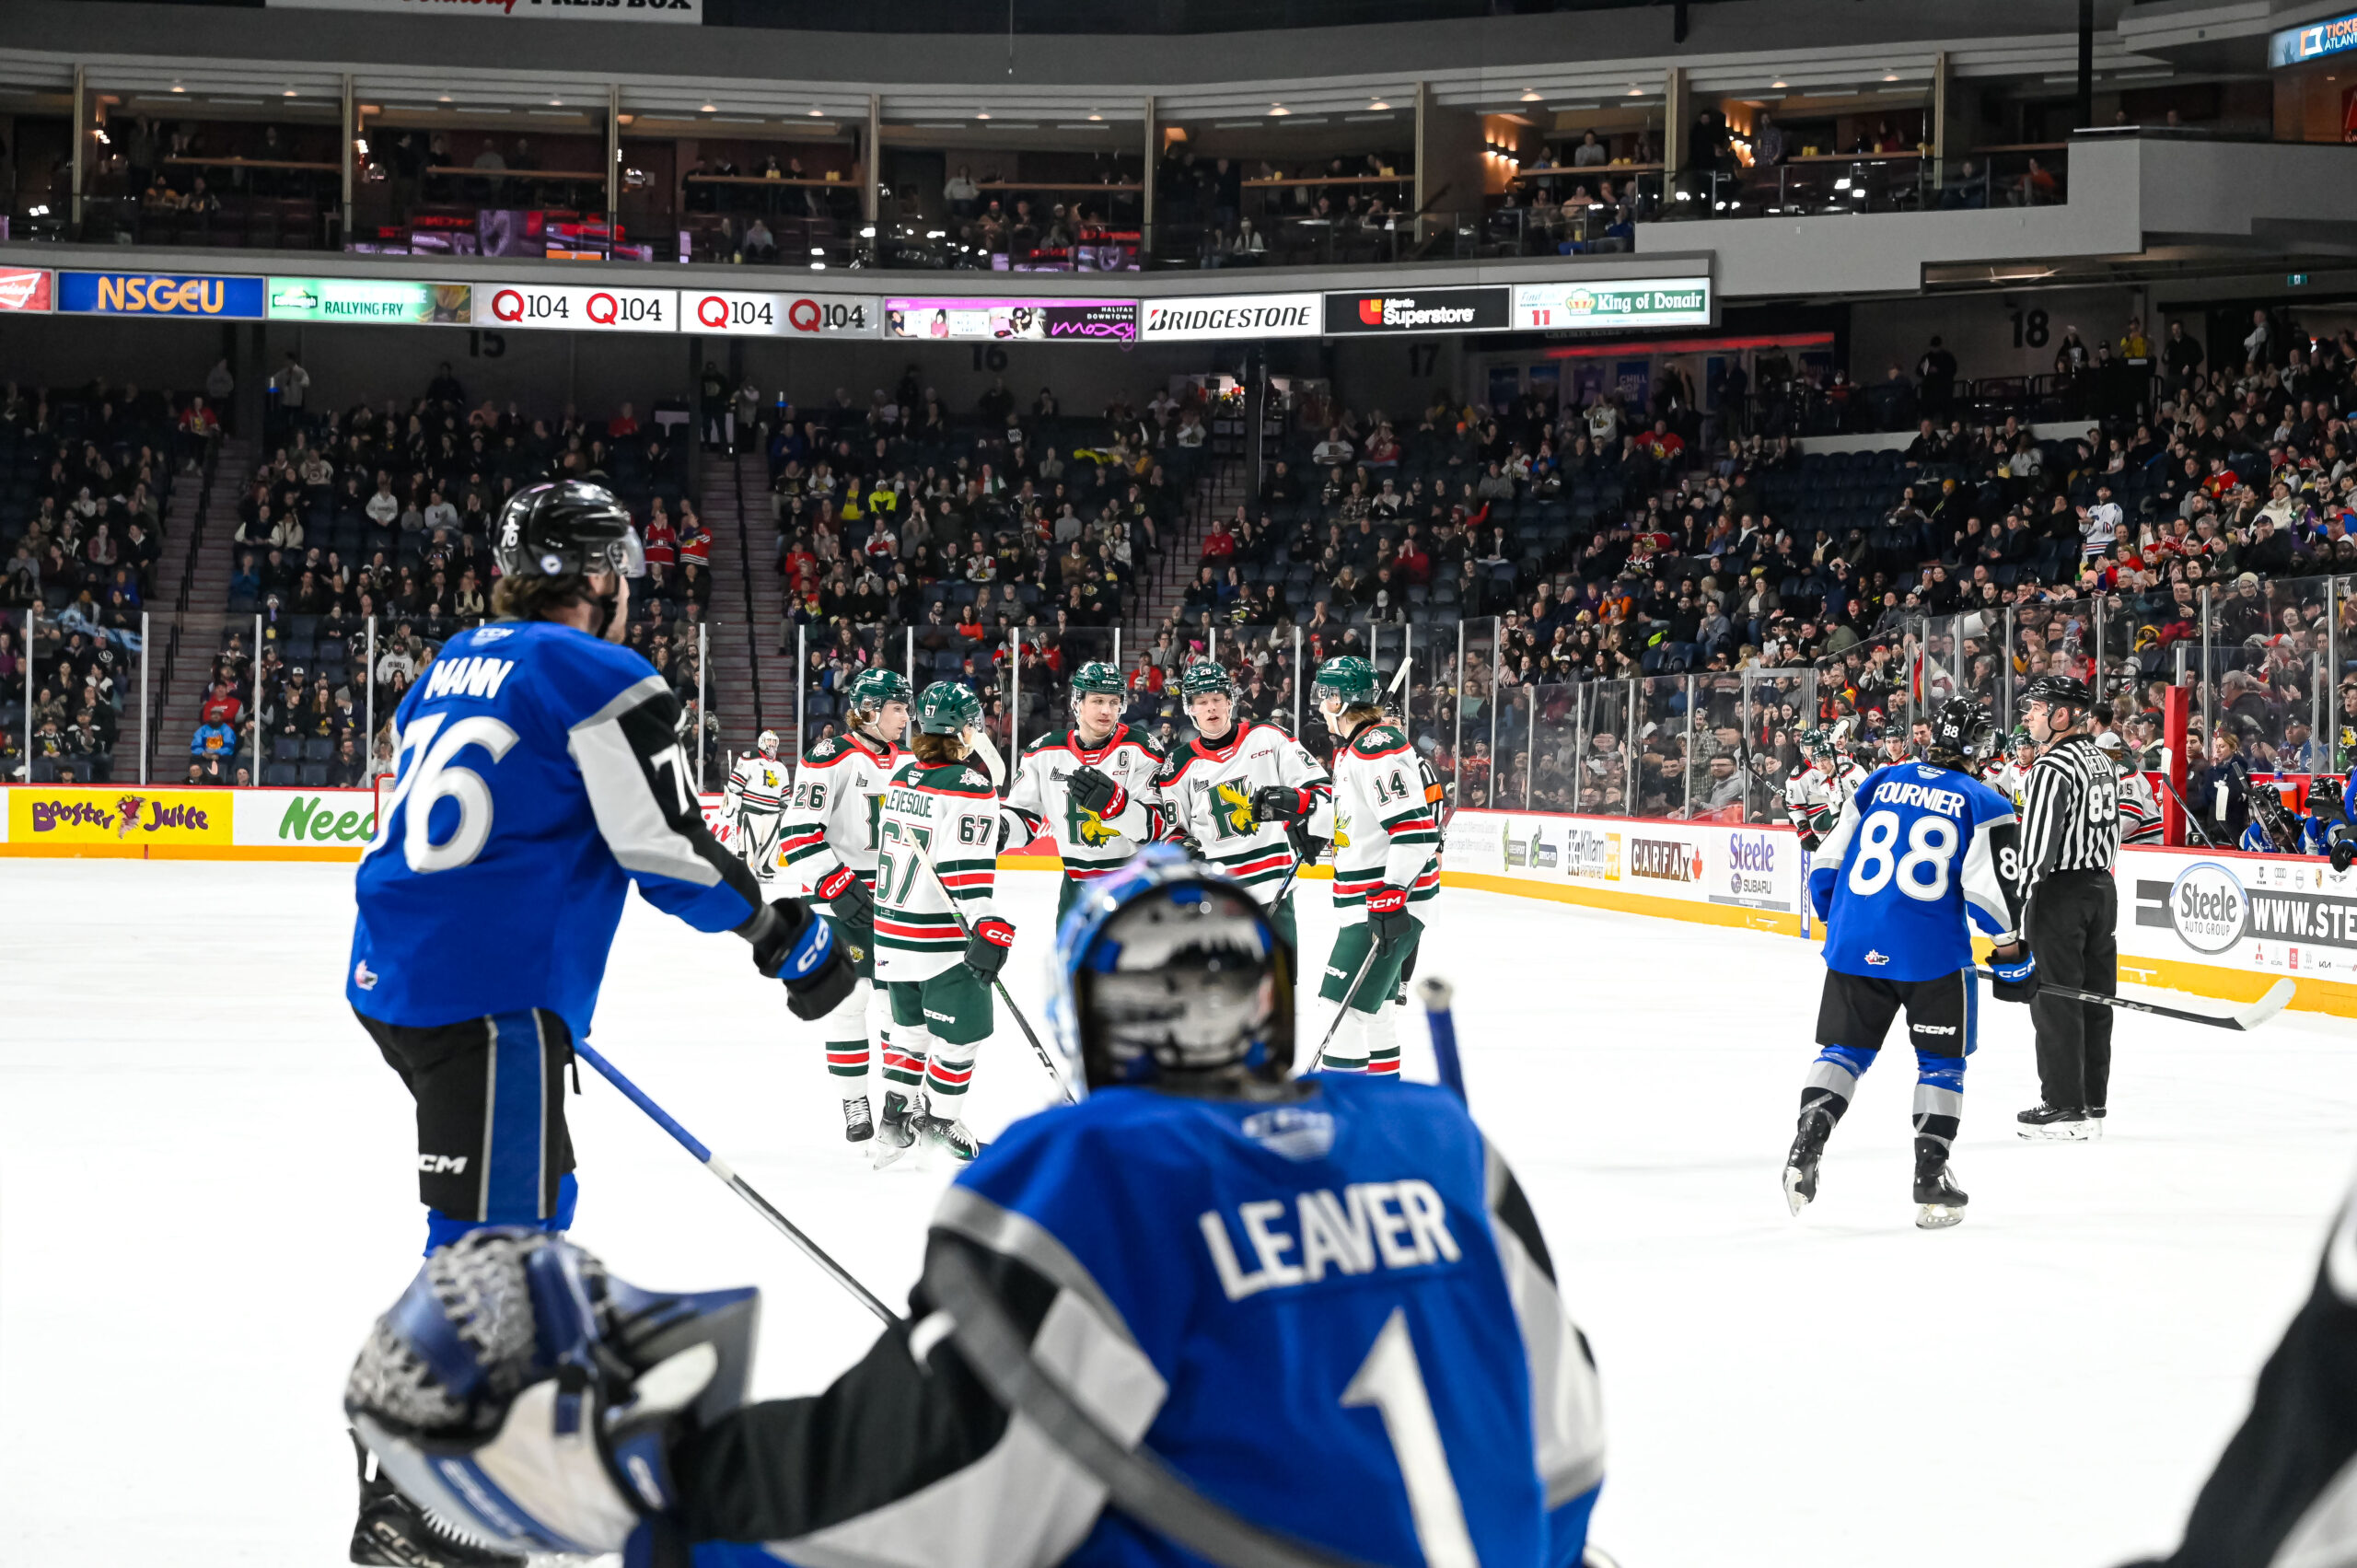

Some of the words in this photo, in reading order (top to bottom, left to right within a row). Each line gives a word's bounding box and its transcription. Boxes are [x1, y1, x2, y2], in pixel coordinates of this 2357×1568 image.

[98, 276, 224, 313] NSGEU
[325, 301, 379, 315] RALLYING
[382, 303, 403, 316] FRY
[1596, 294, 1631, 313] King
[1636, 293, 1649, 309] of
[1655, 292, 1702, 308] Donair
[1147, 307, 1312, 331] BRIDGESTONE
[1383, 307, 1473, 328] Superstore
[1532, 309, 1550, 325] 11
[2009, 309, 2049, 348] 18
[467, 330, 505, 358] 15
[970, 343, 1007, 372] 16
[1409, 343, 1440, 377] 17
[1619, 374, 1647, 384] CHILL
[424, 656, 515, 700] MANN
[924, 704, 936, 717] 67
[1942, 722, 1959, 738] 88
[1117, 749, 1130, 768] C
[1250, 748, 1273, 760] CCM
[2084, 755, 2108, 774] REID
[1916, 764, 1946, 775] CCM
[365, 713, 521, 873] 76
[793, 781, 828, 811] 26
[1374, 769, 1410, 807] 14
[1872, 783, 1966, 819] FOURNIER
[2088, 782, 2116, 823] 83
[32, 800, 115, 832] Booster
[144, 801, 209, 831] Juice
[885, 789, 934, 819] LEVESQUE
[958, 814, 994, 845] 67
[876, 818, 933, 908] 67
[1632, 839, 1691, 882] CARFAX
[1730, 832, 1774, 872] Steele
[1848, 810, 1960, 901] 88
[825, 865, 856, 897] CCM
[1743, 879, 1772, 894] SUBARU
[1366, 895, 1401, 910] CCM
[2181, 882, 2237, 922] Steele
[986, 928, 1014, 944] CC
[2185, 922, 2203, 934] AUTO
[2207, 923, 2230, 936] GROUP
[796, 918, 830, 973] CC
[923, 1007, 956, 1024] CCM
[2078, 993, 2154, 1014] CCM
[1913, 1023, 1956, 1037] CCM
[1199, 1179, 1461, 1302] LEAVER
[1340, 1306, 1482, 1568] 1
